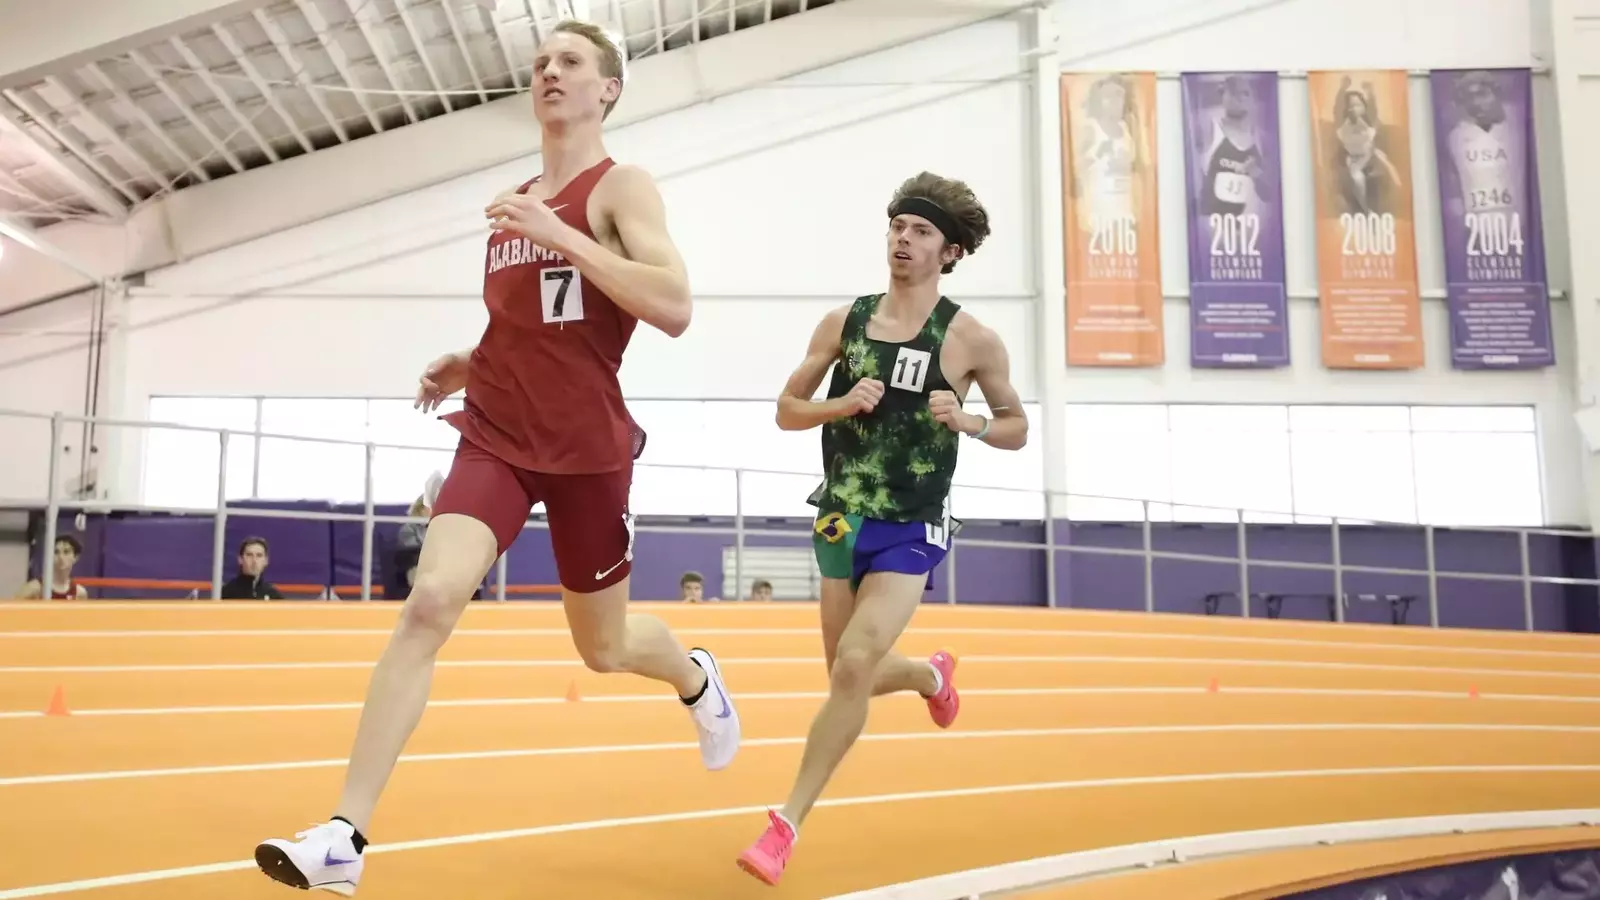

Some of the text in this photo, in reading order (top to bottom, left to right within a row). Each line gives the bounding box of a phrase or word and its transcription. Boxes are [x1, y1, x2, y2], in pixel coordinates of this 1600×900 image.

[1465, 148, 1507, 162] USA
[1088, 213, 1136, 255] 2016
[1210, 212, 1260, 256] 2012
[1340, 211, 1395, 256] 2008
[1465, 211, 1524, 256] 2004
[544, 269, 573, 318] 7
[897, 356, 922, 387] 11
